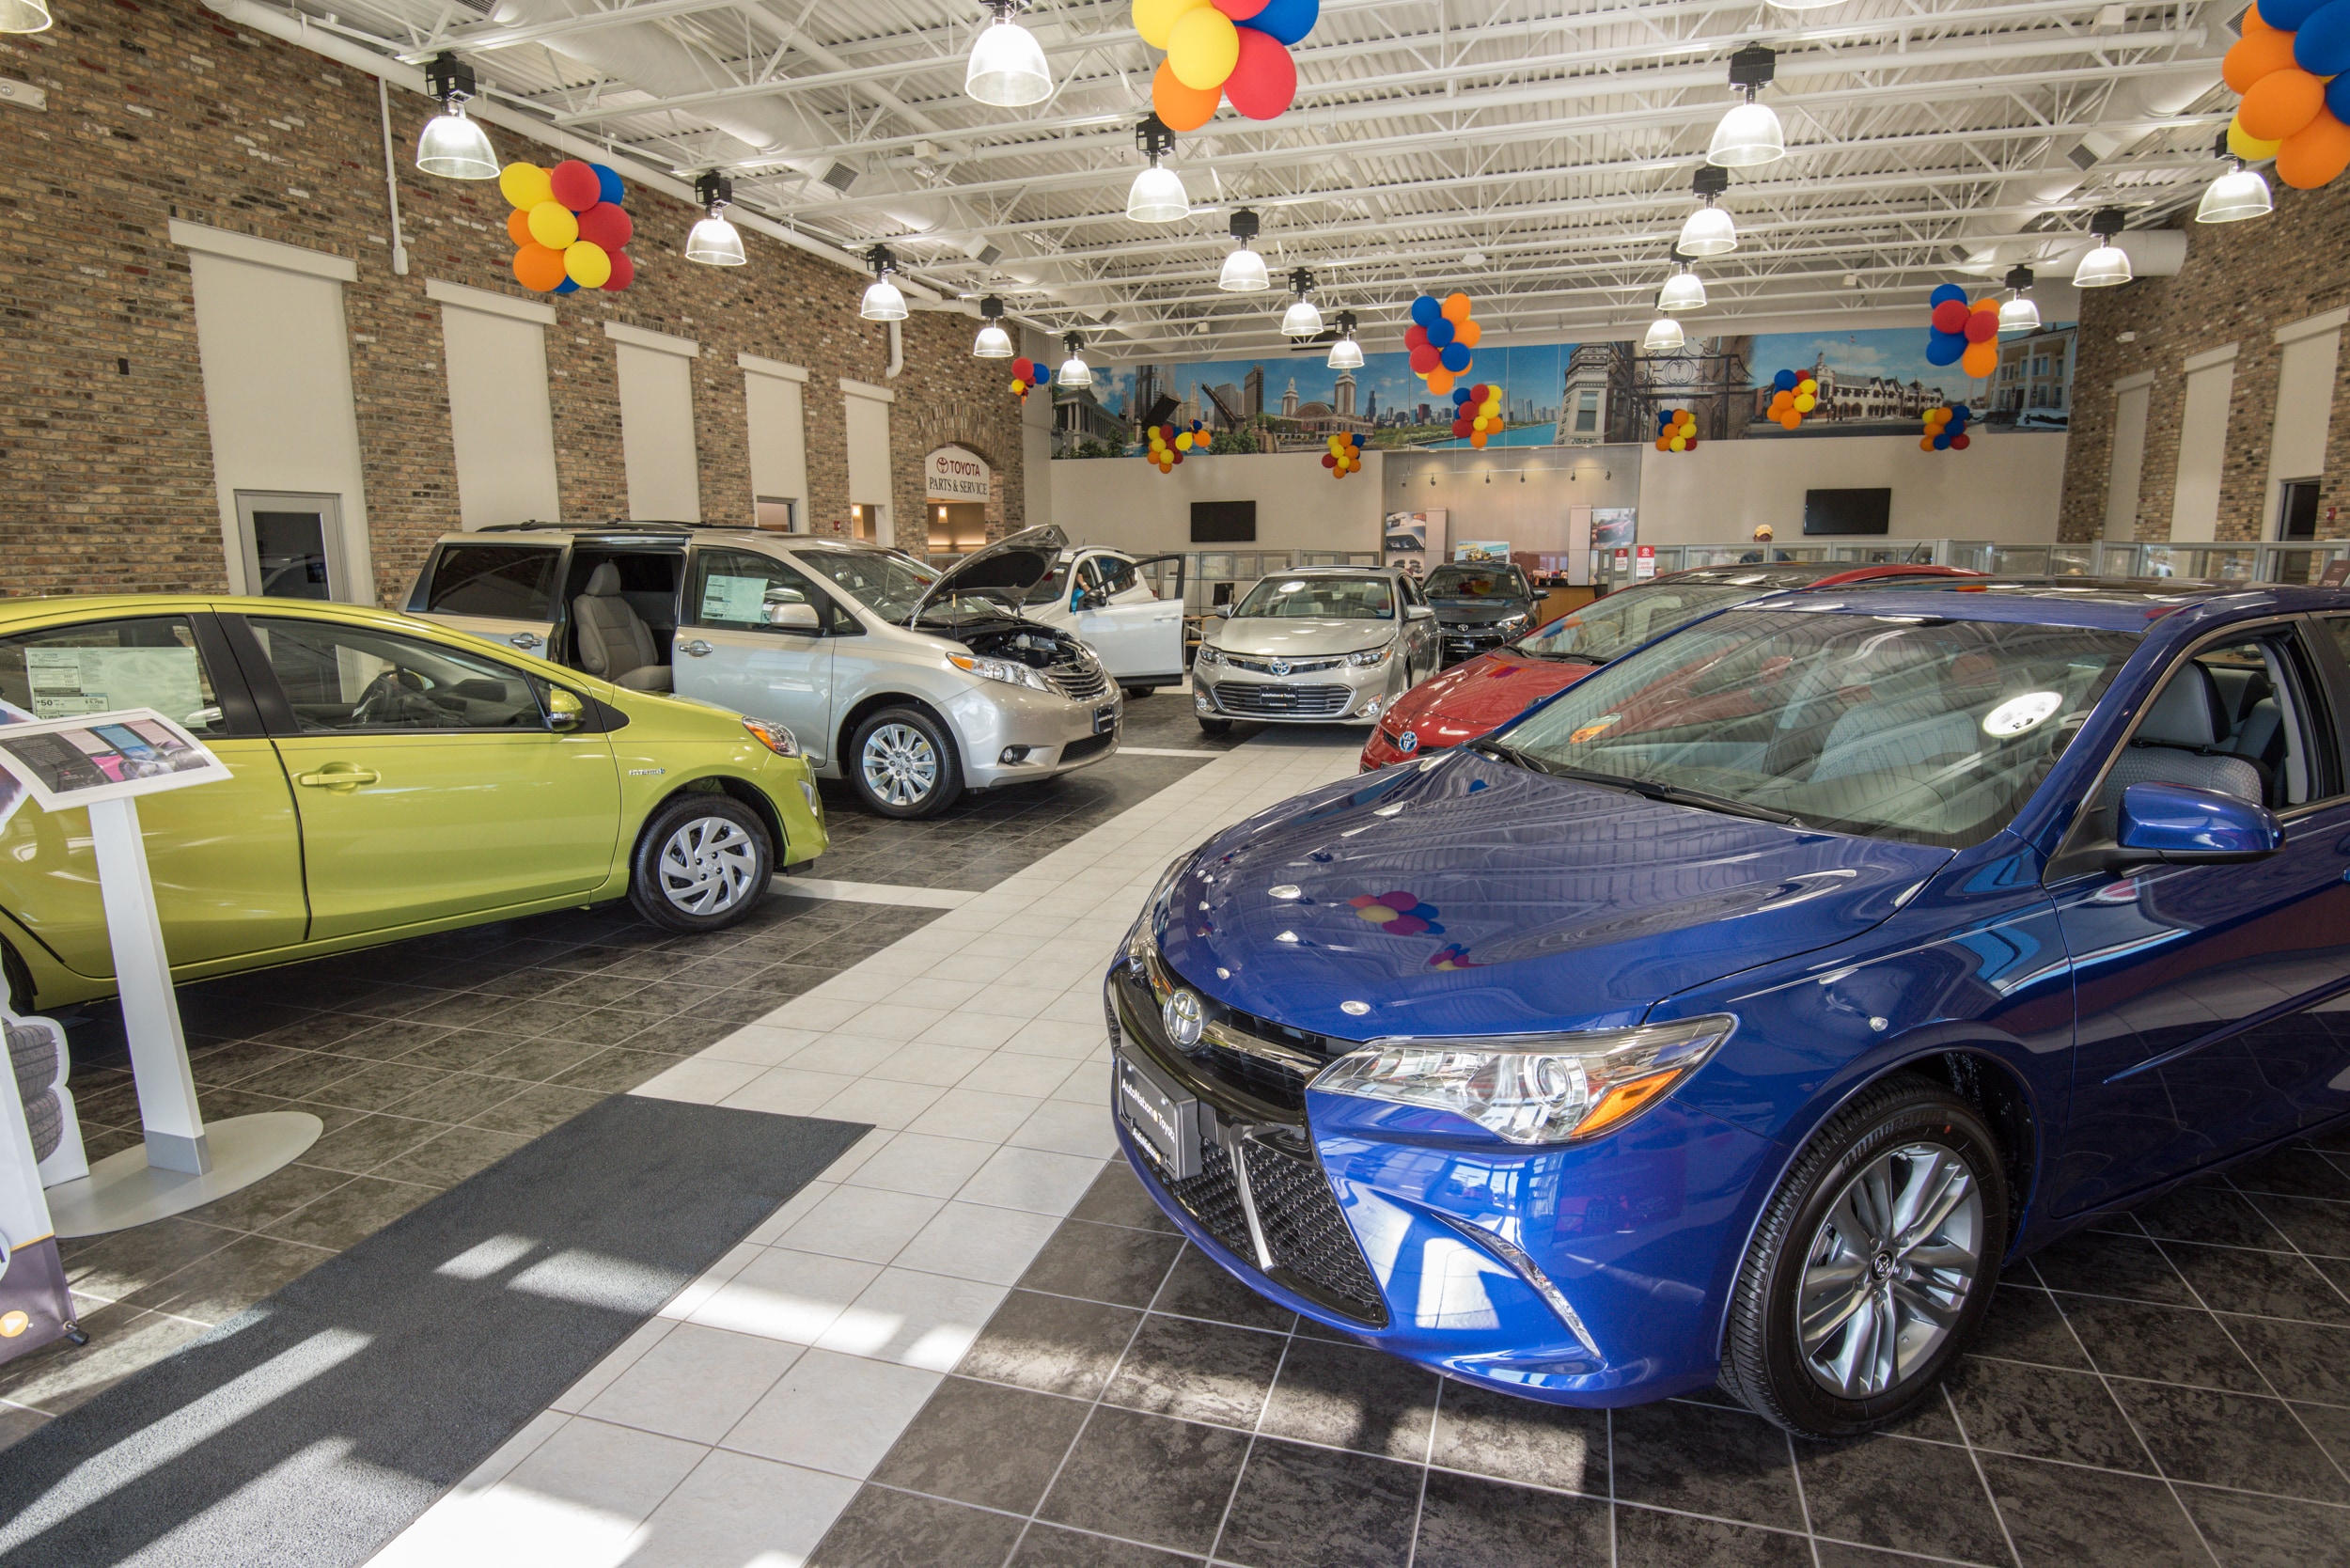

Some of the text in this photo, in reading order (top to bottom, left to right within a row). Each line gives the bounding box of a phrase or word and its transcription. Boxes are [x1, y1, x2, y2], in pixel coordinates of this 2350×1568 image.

[949, 460, 980, 477] TOYOTA
[929, 477, 988, 495] PARTS & SERVICE
[1121, 1078, 1176, 1143] AutoNation Toyota
